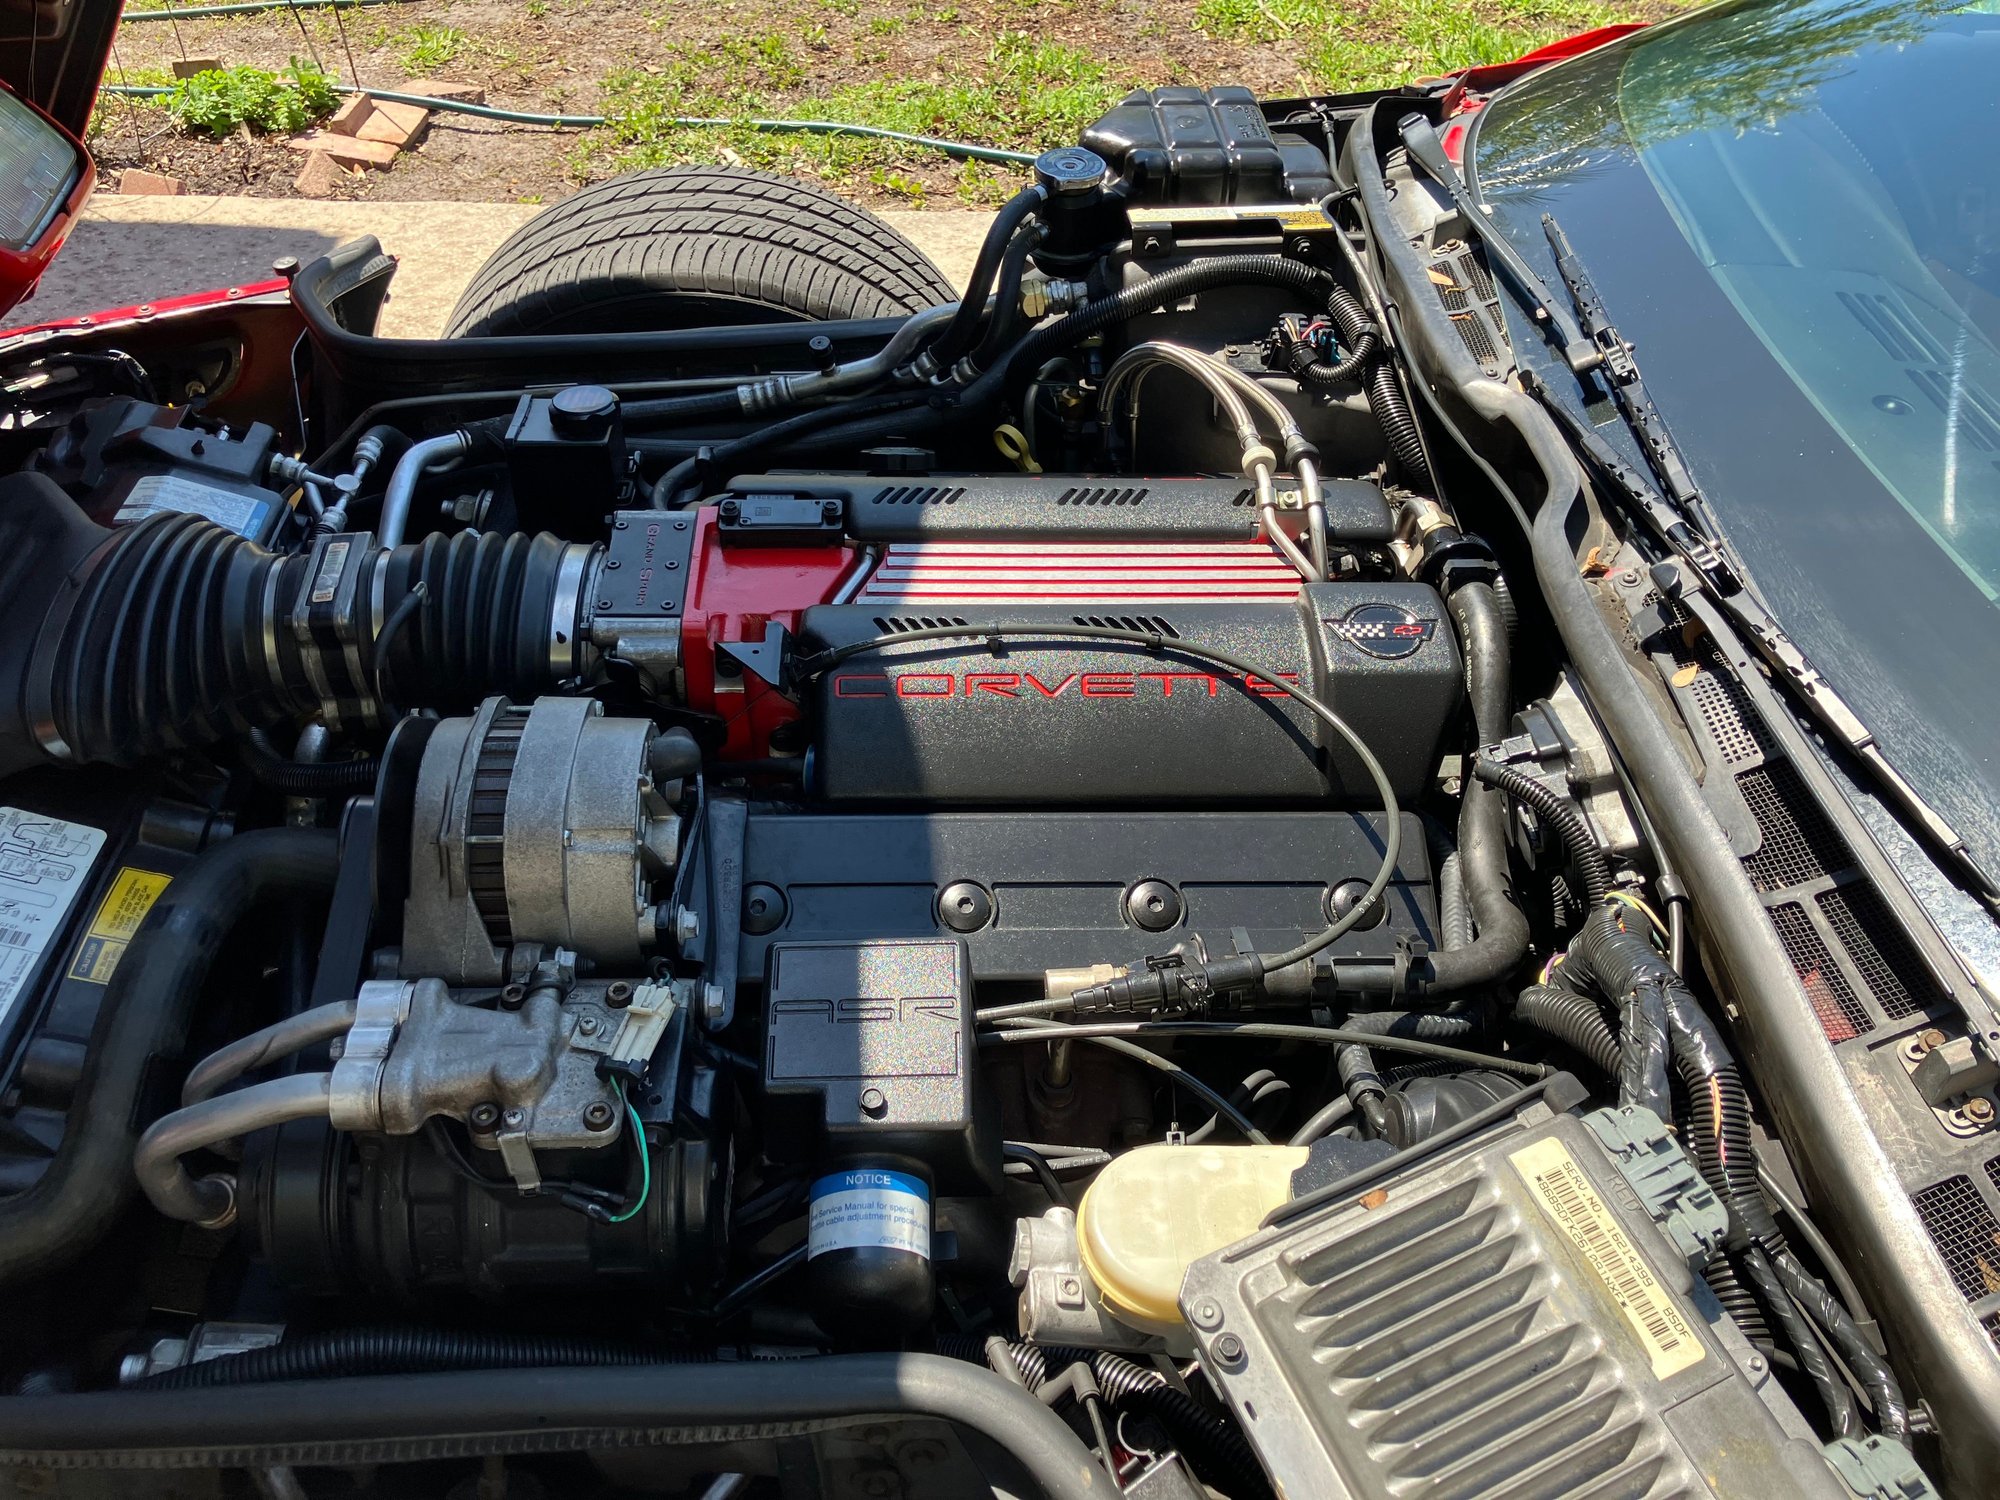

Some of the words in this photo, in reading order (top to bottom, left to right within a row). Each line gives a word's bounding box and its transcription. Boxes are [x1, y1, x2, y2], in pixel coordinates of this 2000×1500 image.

[646, 522, 661, 565] GRAND
[635, 567, 654, 608] SPORT
[834, 672, 1299, 699] CORVETTE
[80, 943, 97, 973] CAUTION
[771, 996, 959, 1025] ASR
[845, 1174, 892, 1186] NOTICE
[1605, 1176, 1642, 1212] RED
[818, 1205, 842, 1219] Service
[844, 1201, 875, 1211] Manual
[877, 1201, 888, 1210] for
[889, 1205, 915, 1216] special
[826, 1214, 845, 1226] cable
[847, 1213, 892, 1224] adjustment
[1607, 1227, 1654, 1287] 16214399
[1663, 1307, 1691, 1339] BSDF
